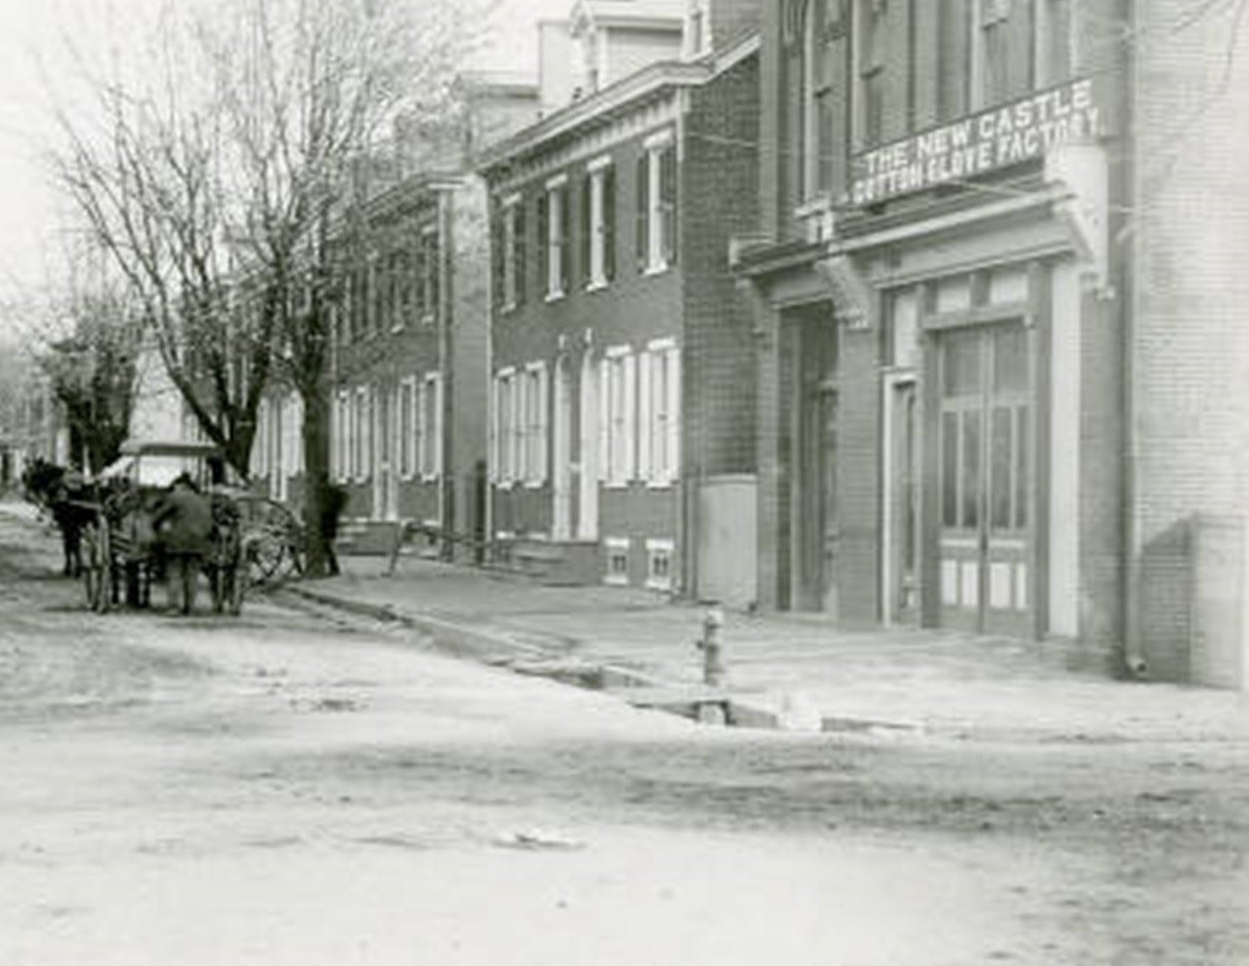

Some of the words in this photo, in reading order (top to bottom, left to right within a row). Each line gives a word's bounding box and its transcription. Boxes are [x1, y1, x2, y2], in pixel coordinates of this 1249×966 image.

[853, 162, 923, 204] COTTON
[928, 143, 991, 183] GLOVE
[998, 108, 1100, 162] FACTORY
[865, 143, 908, 174] THE
[917, 120, 969, 158] NEW
[979, 80, 1092, 139] CASTLE
